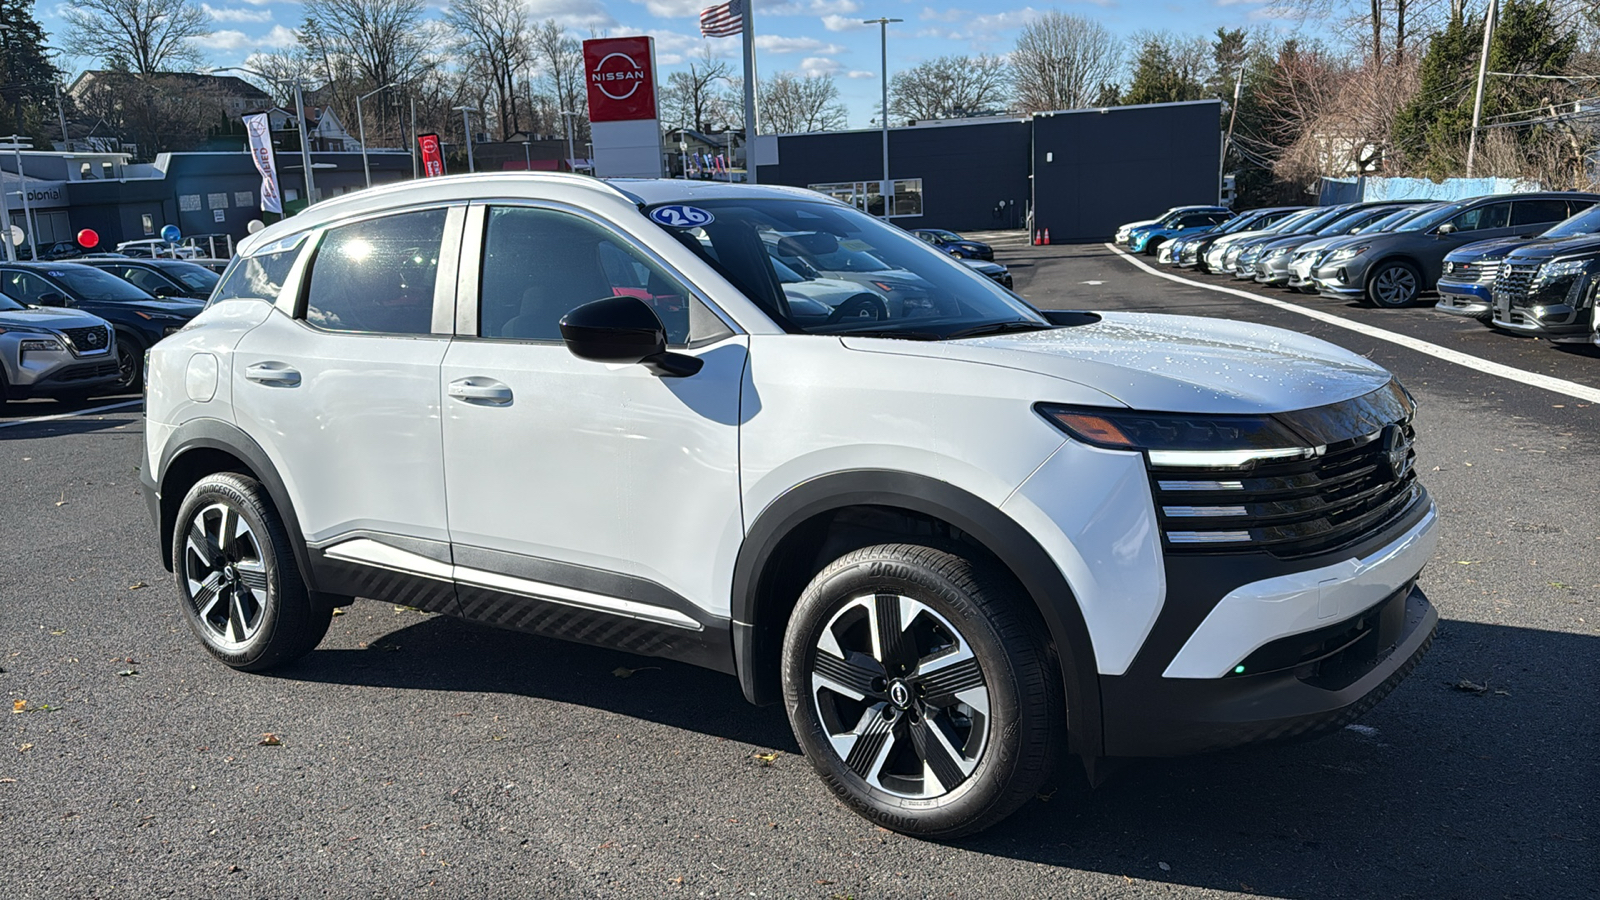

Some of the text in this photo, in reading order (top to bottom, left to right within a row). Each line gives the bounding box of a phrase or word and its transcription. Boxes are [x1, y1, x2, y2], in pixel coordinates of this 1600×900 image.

[592, 70, 644, 82] NISSAN
[661, 205, 706, 226] 26
[197, 484, 247, 507] BRIDGESTONE
[869, 561, 977, 621] BRIDGESTONE
